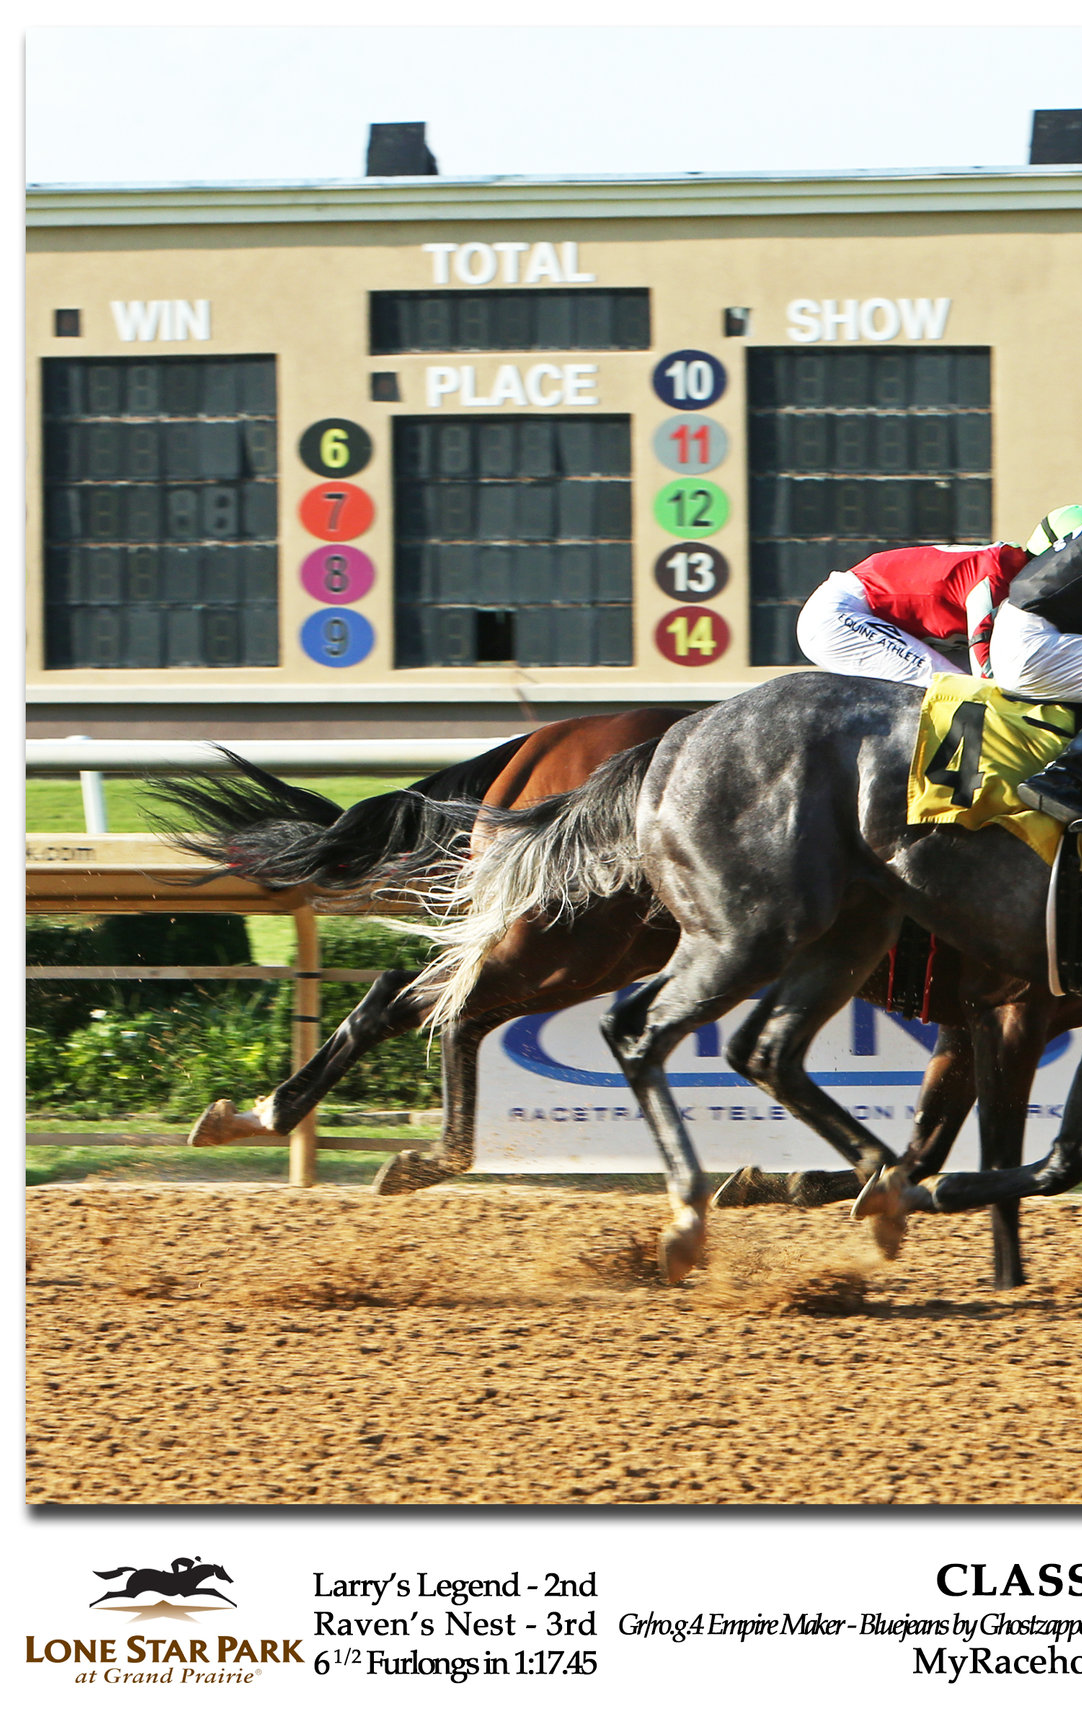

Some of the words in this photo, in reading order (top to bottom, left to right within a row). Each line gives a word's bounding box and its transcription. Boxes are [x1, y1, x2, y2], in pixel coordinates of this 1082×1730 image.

[422, 241, 597, 285] TOTAL
[110, 299, 212, 342] WIN
[786, 297, 952, 343] SHOW
[426, 363, 600, 408] PLACE
[665, 360, 714, 401] 10
[320, 428, 350, 468] 6
[669, 424, 711, 464] 11
[322, 492, 347, 531] 7
[667, 489, 713, 528] 12
[323, 555, 349, 593] 8
[666, 552, 717, 593] 13
[322, 617, 349, 657] 9
[666, 616, 718, 657] 14
[838, 612, 878, 642] EQUINE
[878, 638, 926, 668] ATHLETE
[925, 701, 988, 809] 4
[508, 1106, 697, 1122] RACETRAK
